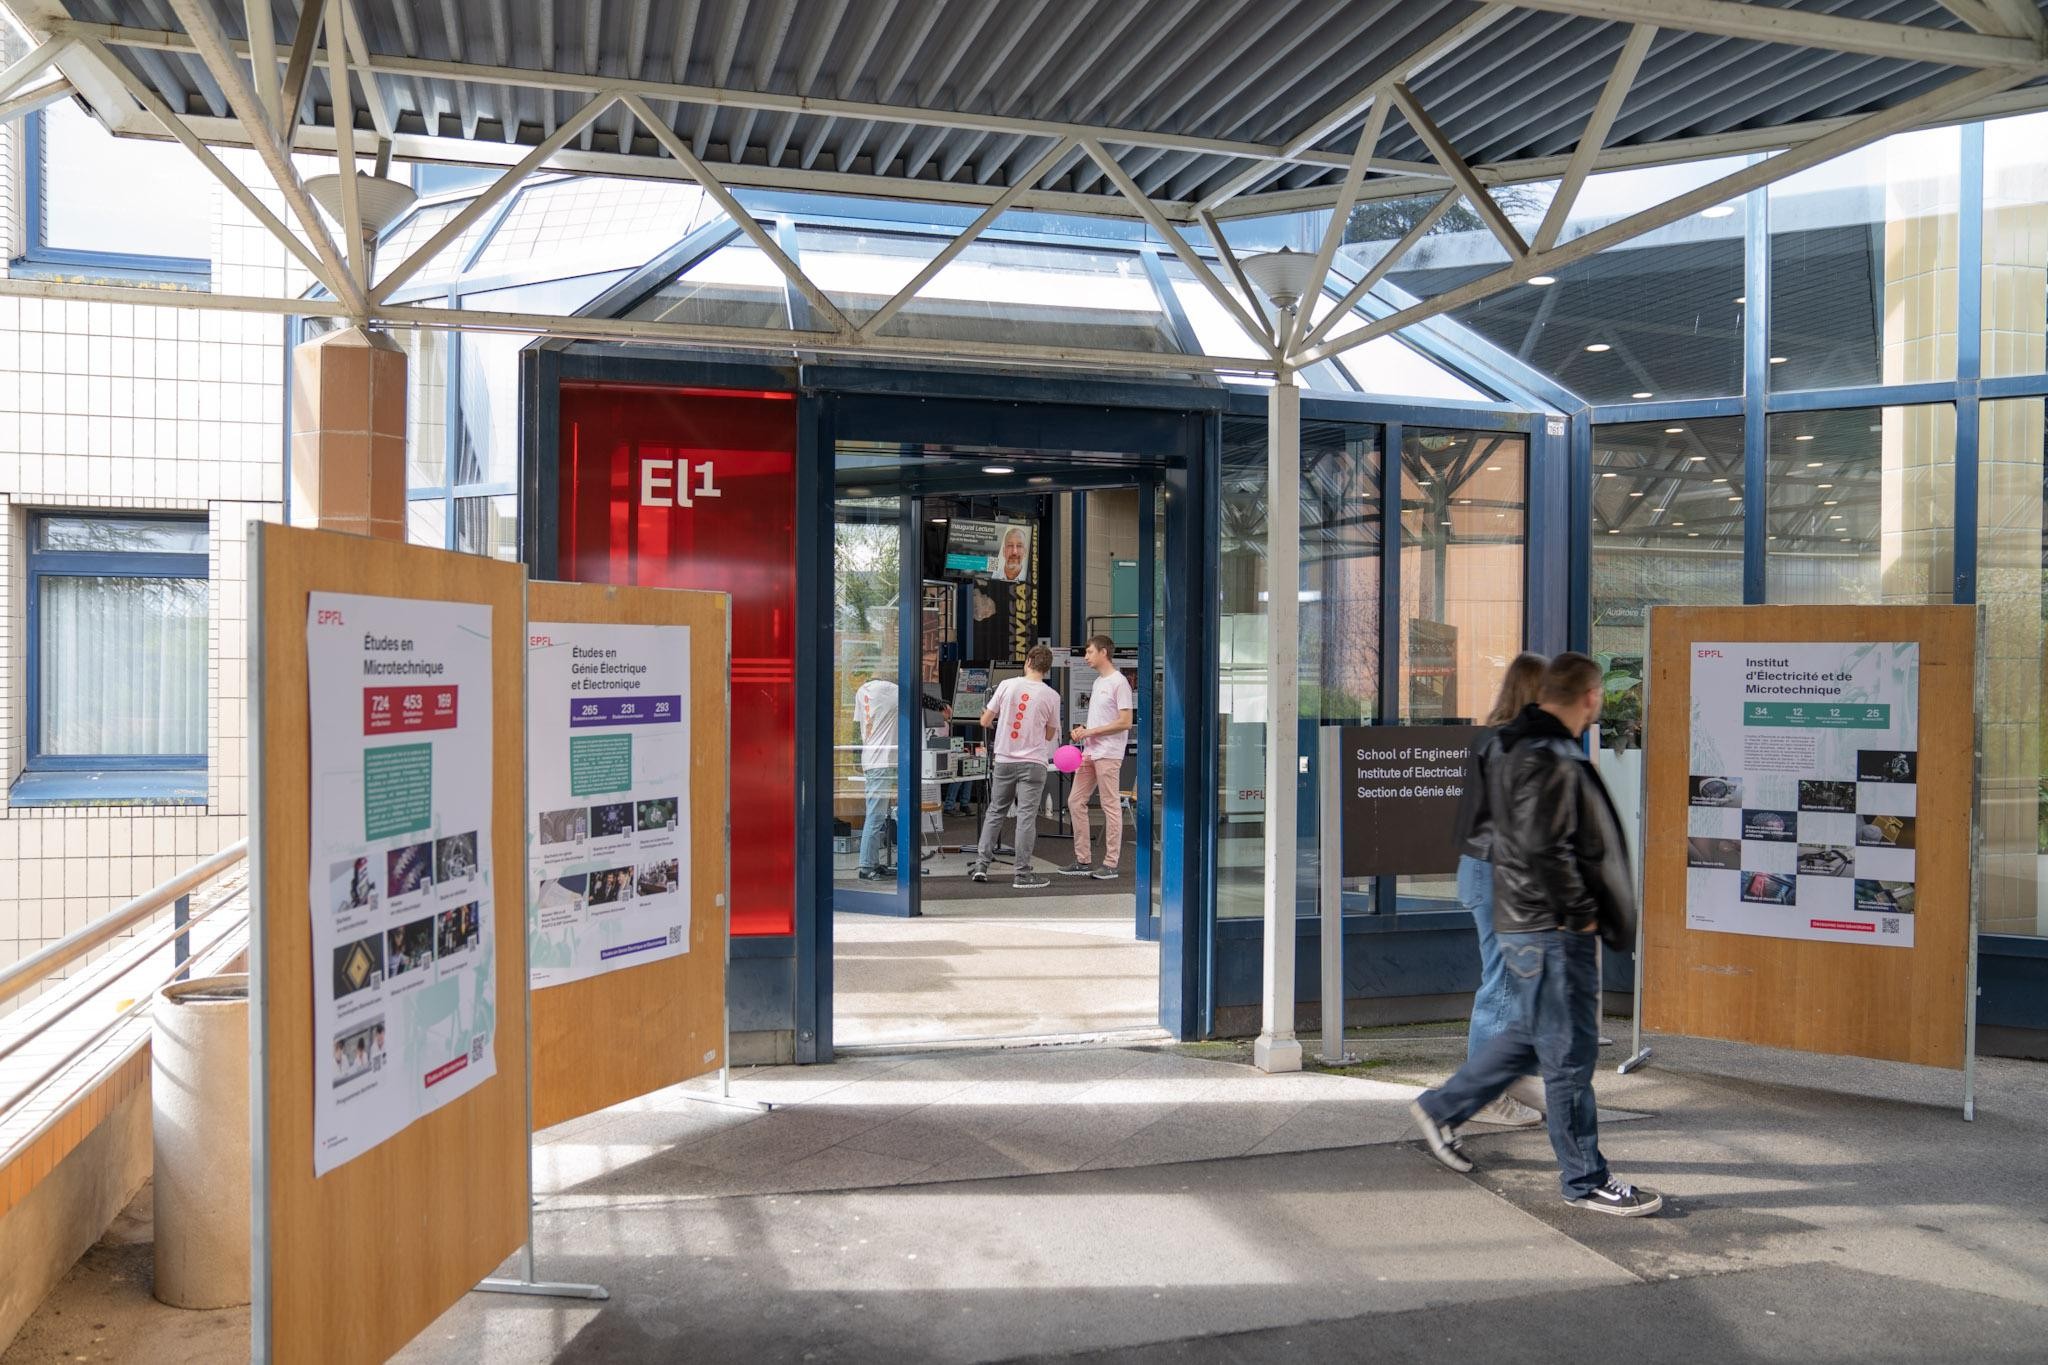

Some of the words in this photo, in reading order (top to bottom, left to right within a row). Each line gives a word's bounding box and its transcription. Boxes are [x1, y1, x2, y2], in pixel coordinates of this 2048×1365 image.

[317, 610, 344, 626] EPFL
[1016, 583, 1026, 661] ENVISA
[364, 632, 399, 652] Études
[401, 639, 413, 652] en
[530, 636, 553, 647] EPFL
[572, 645, 603, 658] Études
[605, 648, 617, 658] en
[1698, 650, 1723, 658] EPFL
[363, 659, 444, 678] Microtechnique
[571, 663, 598, 674] Génie
[600, 661, 647, 675] Électrique
[1746, 657, 1789, 668] Institut
[1746, 669, 1819, 681] d'Électricité
[1821, 672, 1834, 681] et
[1836, 671, 1853, 681] de
[571, 680, 581, 690] et
[583, 677, 641, 691] Électronique
[1746, 684, 1841, 697] Microtechnique
[371, 695, 389, 712] 724
[403, 694, 423, 710] 453
[582, 704, 598, 716] 265
[621, 703, 635, 714] 231
[1755, 707, 1767, 715] 34
[1793, 708, 1803, 716] 12
[1830, 708, 1840, 716] 12
[1866, 709, 1880, 717] 25
[1357, 748, 1397, 760] School
[1399, 748, 1412, 760] of
[1358, 768, 1401, 779] Institute
[1402, 767, 1414, 778] of
[1415, 766, 1462, 778] Electrical
[1239, 790, 1264, 800] EPFL
[1358, 787, 1397, 798] Section
[1399, 786, 1412, 797] de
[1414, 785, 1444, 797] Génie
